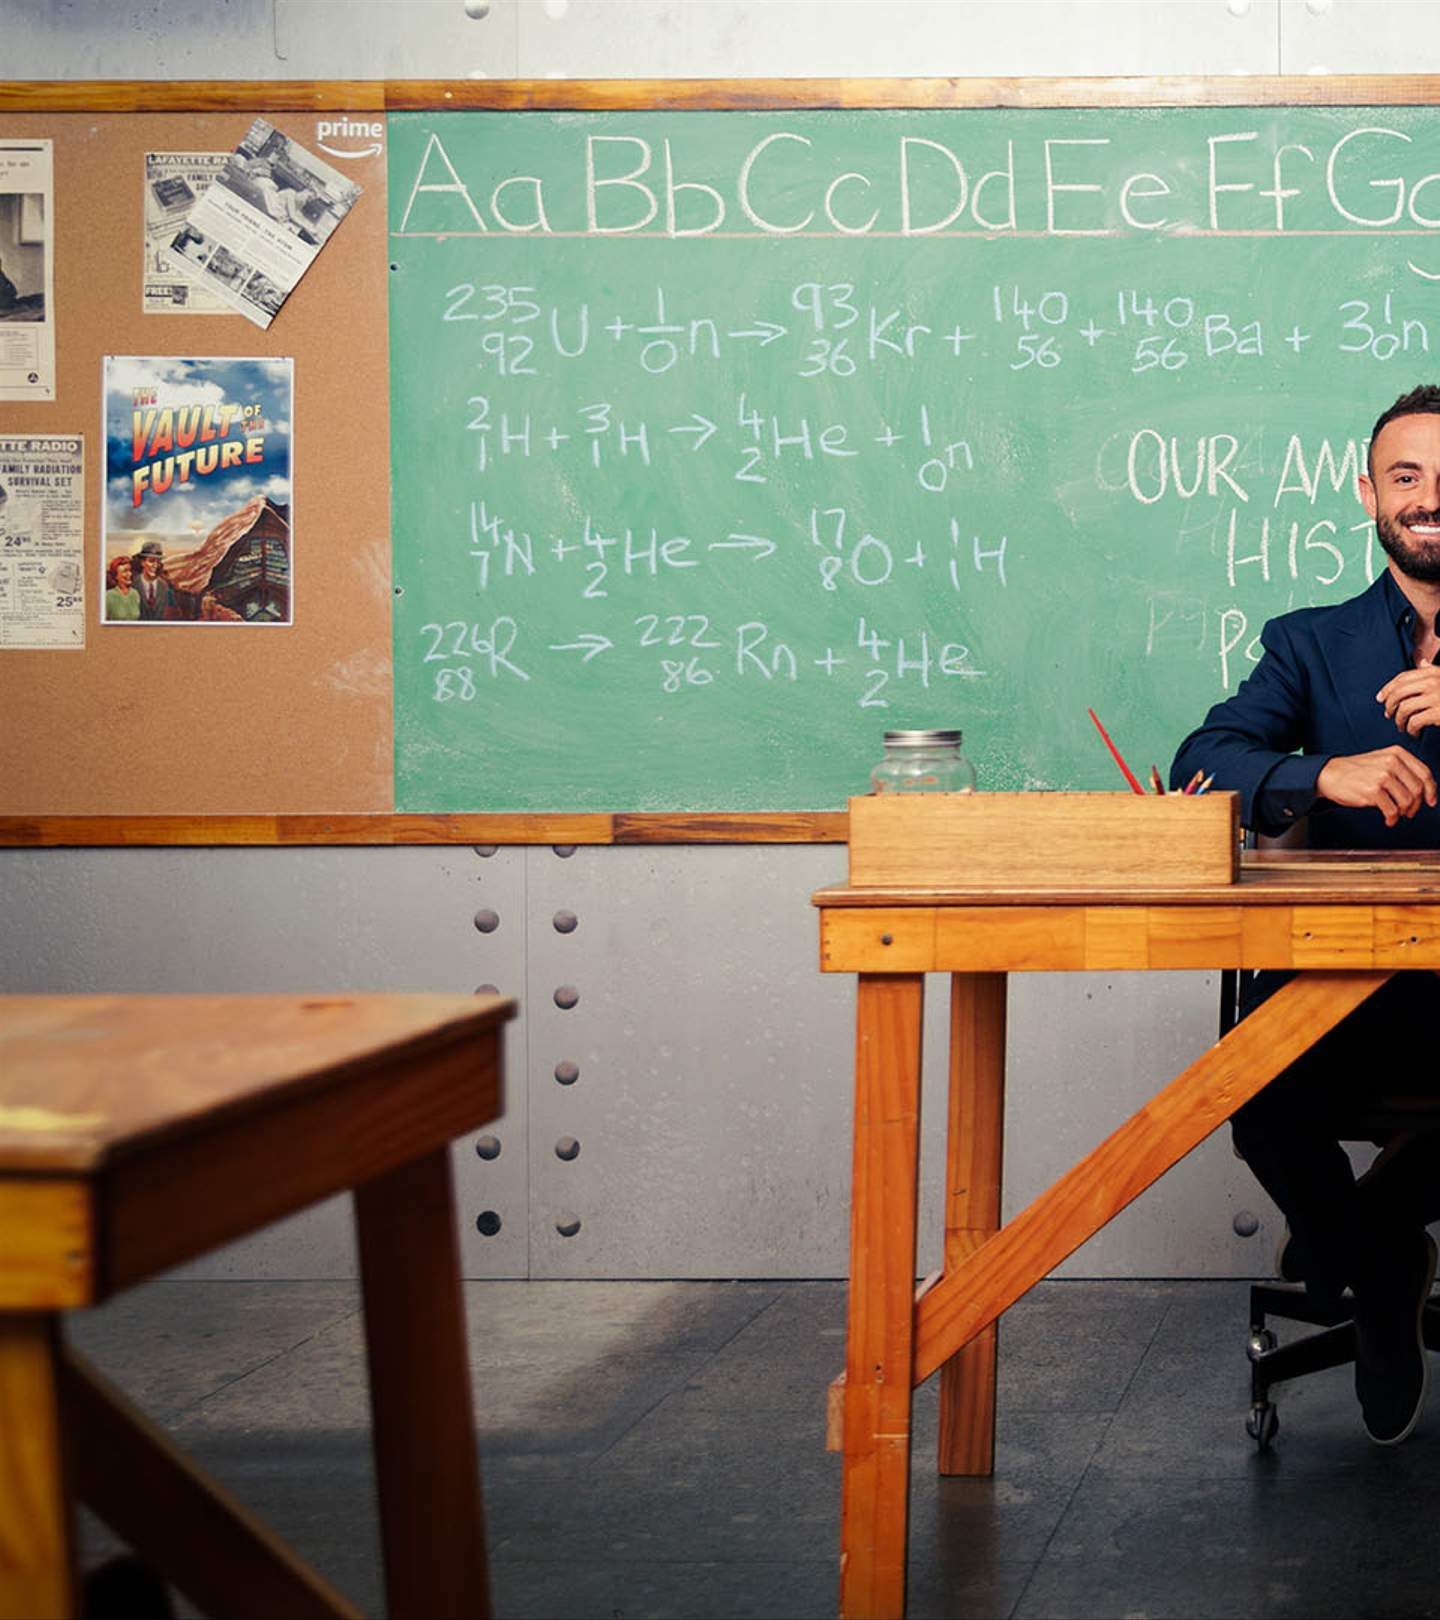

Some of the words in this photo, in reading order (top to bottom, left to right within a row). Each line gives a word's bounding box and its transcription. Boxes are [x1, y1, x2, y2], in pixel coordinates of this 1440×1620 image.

[317, 117, 383, 141] prime
[400, 134, 552, 233] Aa
[587, 136, 726, 238] Bb
[738, 133, 880, 235] Cc
[900, 136, 1017, 235] Dd
[1044, 138, 1172, 235] Ee
[1208, 131, 1314, 231] Ff
[133, 387, 157, 406] THE
[32, 440, 78, 452] RADIO
[132, 404, 240, 462] VAULT
[243, 404, 262, 418] OF
[54, 477, 72, 487] SET
[132, 437, 265, 508] FUTURE
[1128, 429, 1248, 504] OUR
